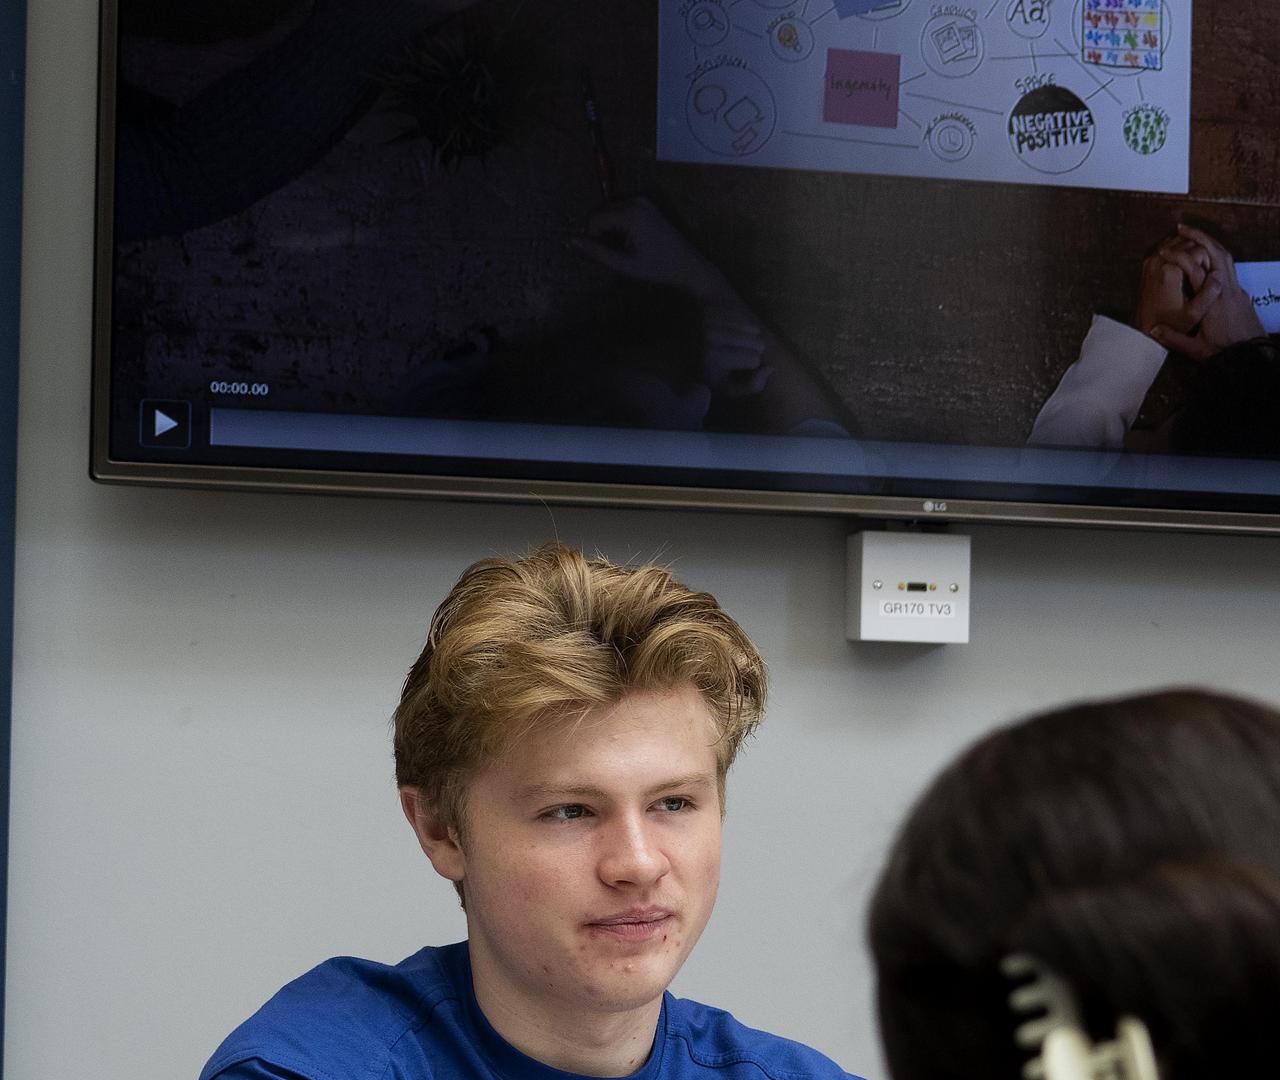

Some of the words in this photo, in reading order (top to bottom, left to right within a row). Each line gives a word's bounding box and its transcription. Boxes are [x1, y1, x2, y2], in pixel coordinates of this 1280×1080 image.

[1011, 110, 1091, 133] NEGATIVE
[1016, 127, 1089, 153] POSITIVE
[210, 381, 269, 395] 00:00.00
[883, 602, 925, 614] GR170
[928, 603, 951, 615] TV3
